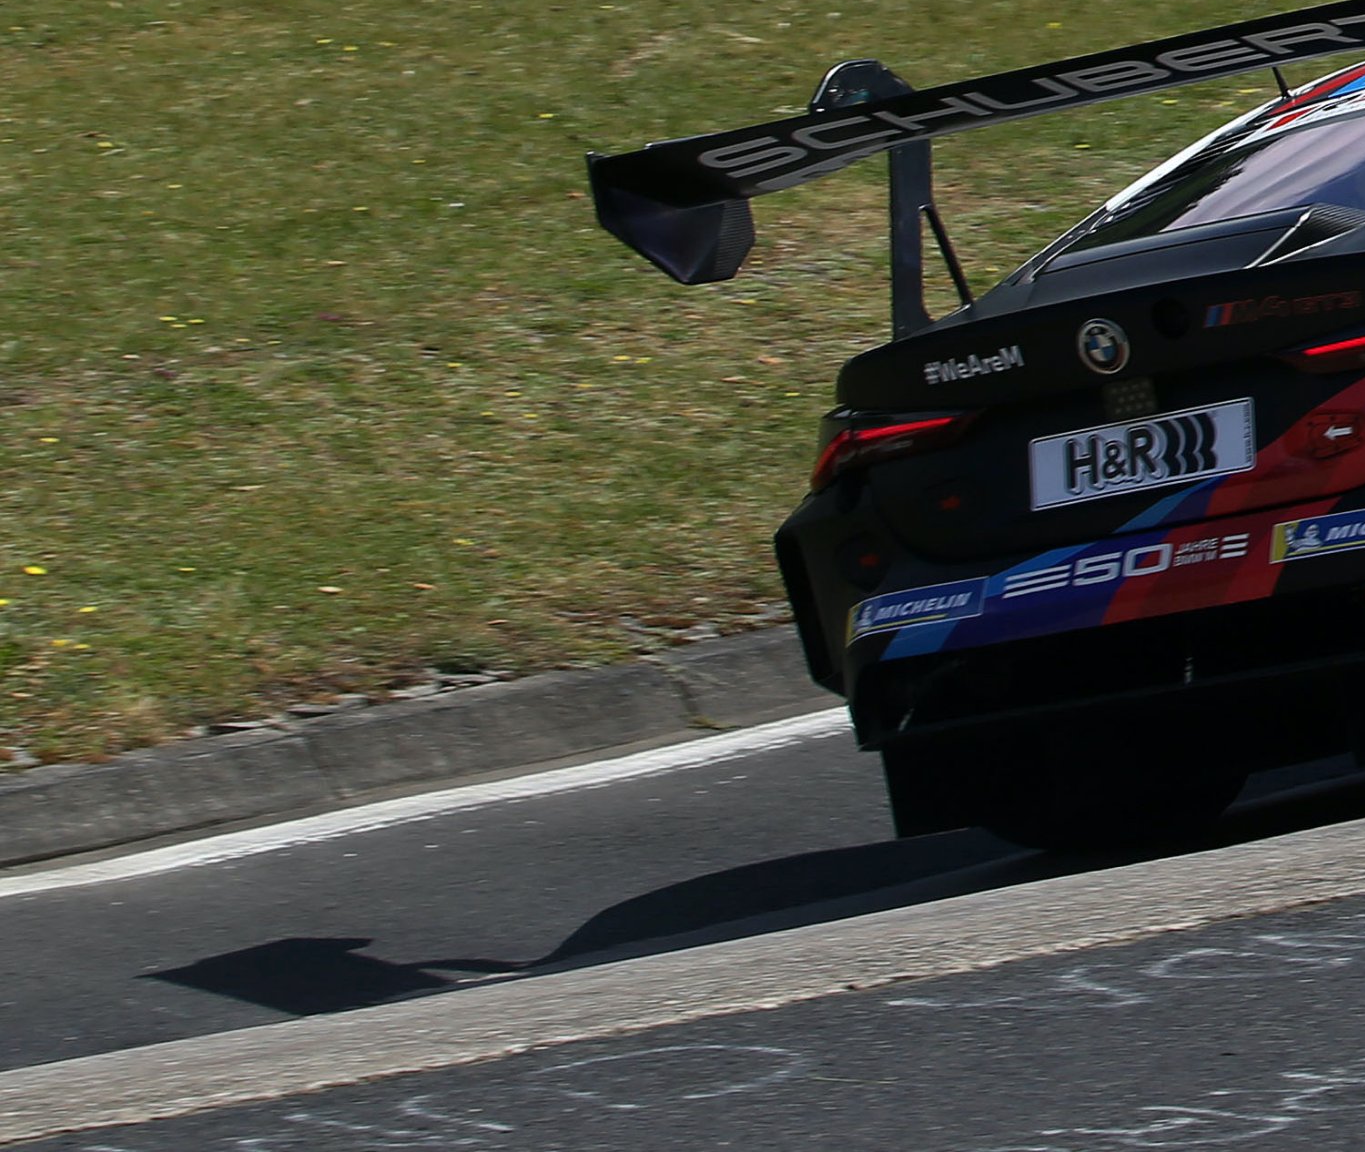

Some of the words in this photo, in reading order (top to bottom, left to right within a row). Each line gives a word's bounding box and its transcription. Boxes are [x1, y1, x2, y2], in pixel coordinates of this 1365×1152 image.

[923, 344, 1025, 386] #WeAreM
[1064, 425, 1167, 496] H&R
[1073, 543, 1174, 587] 50
[1175, 537, 1220, 555] JAHRE
[872, 590, 971, 625] MICHELIN
